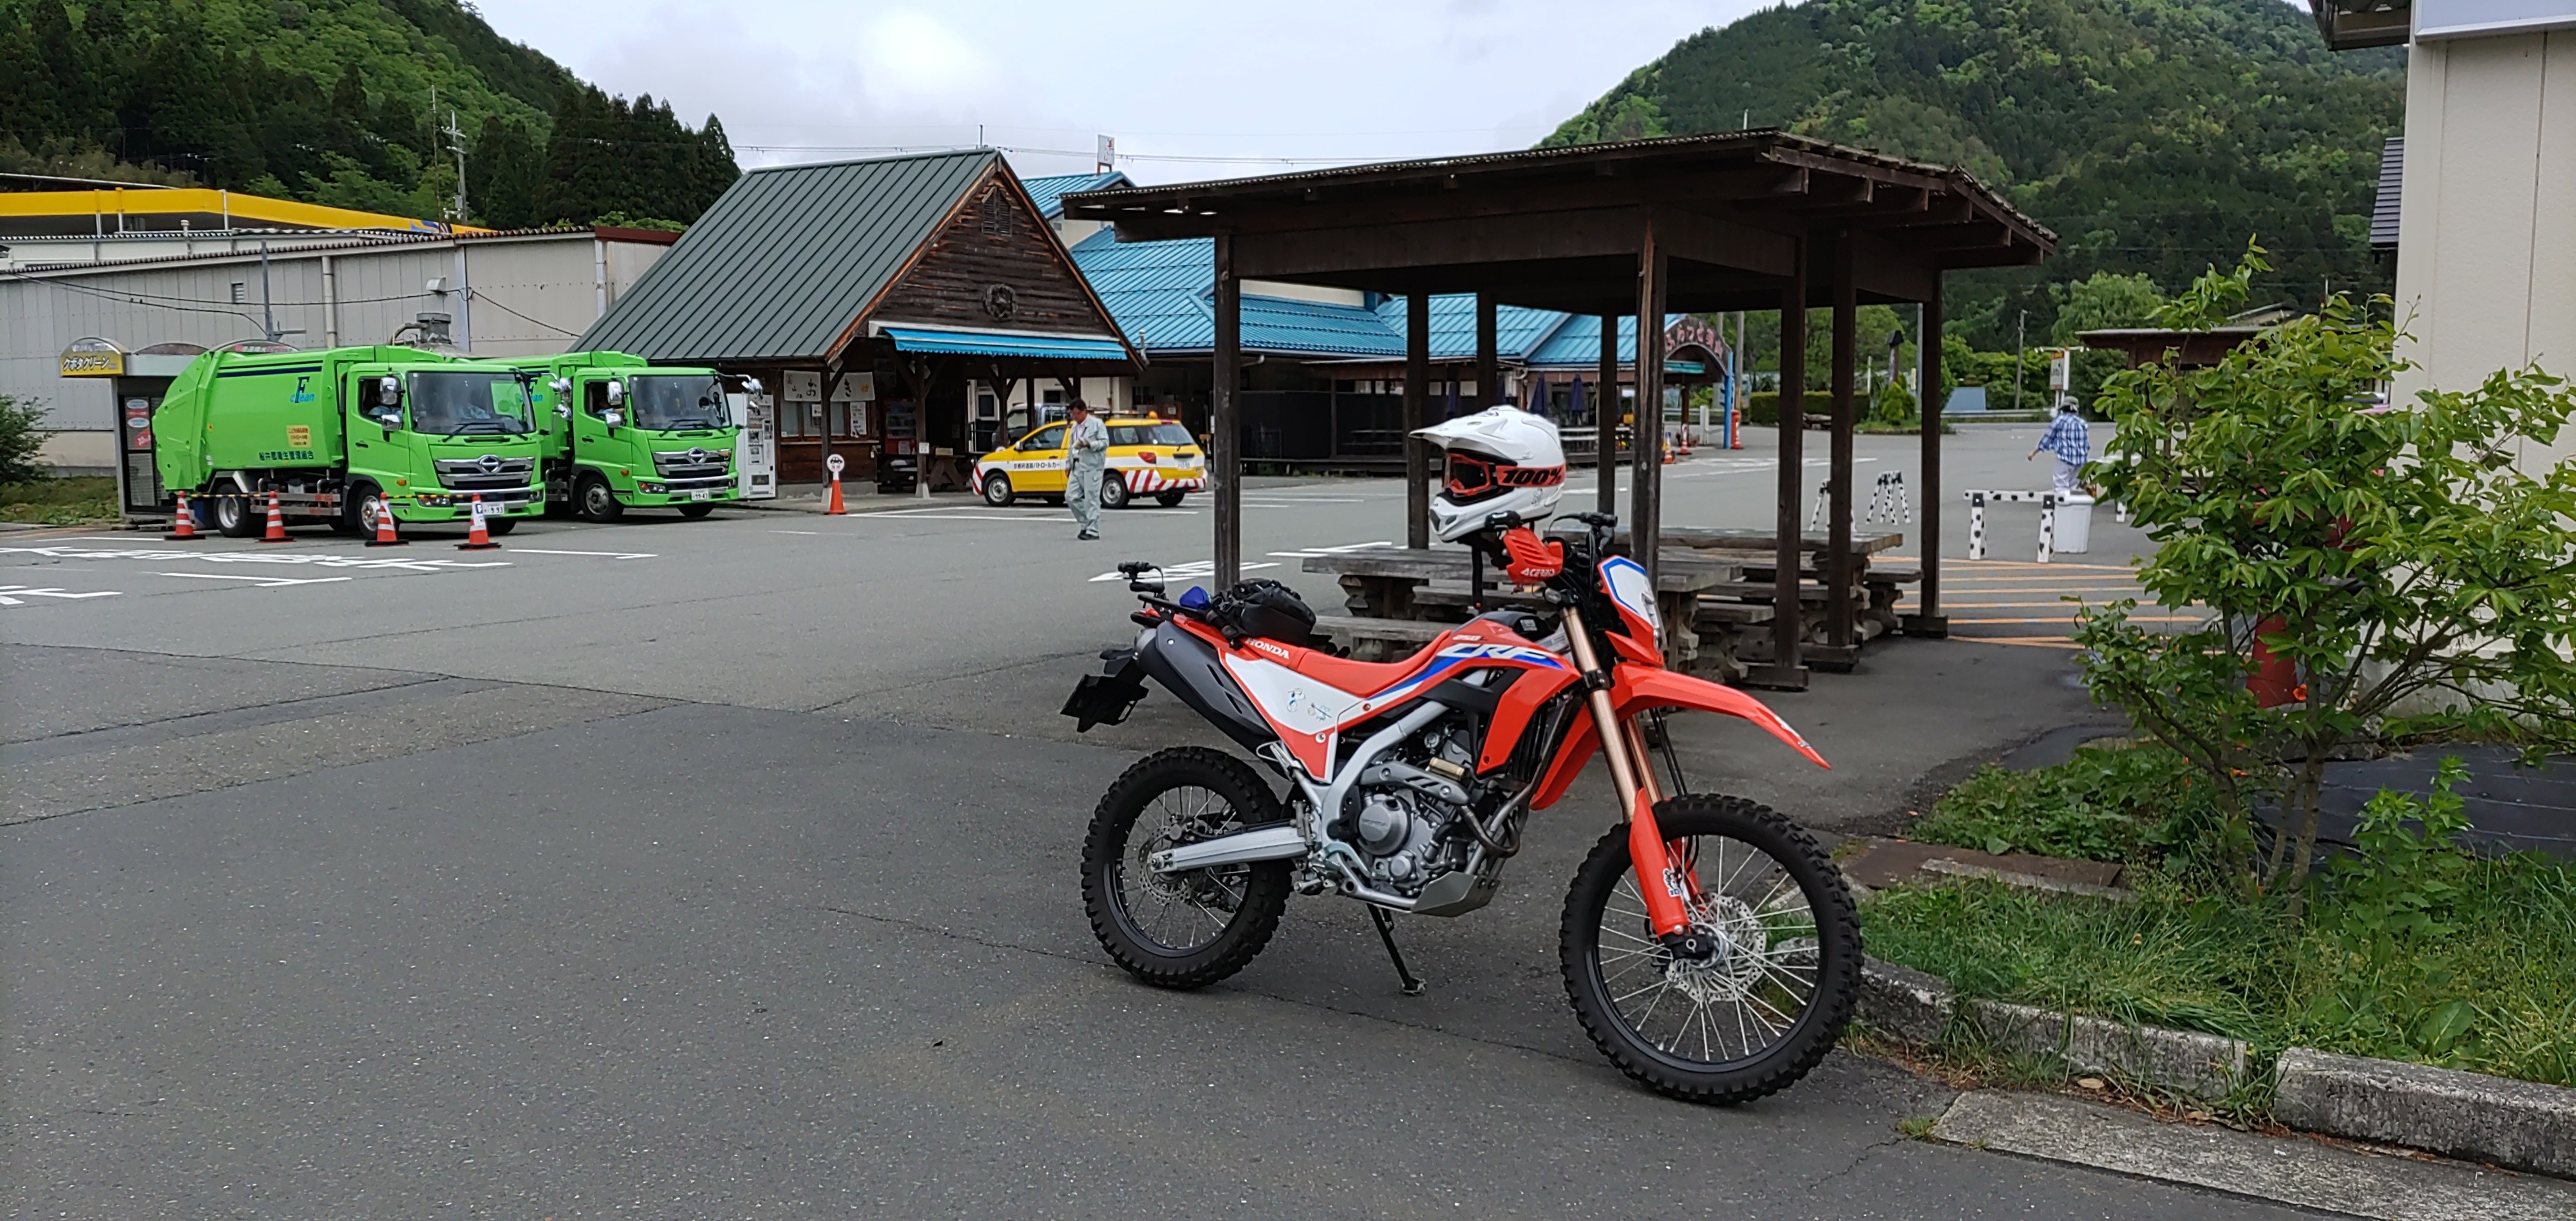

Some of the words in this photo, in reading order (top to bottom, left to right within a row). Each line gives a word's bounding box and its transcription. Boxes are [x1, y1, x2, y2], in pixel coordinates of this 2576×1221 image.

[63, 355, 109, 371] クボタクリーン
[1501, 467, 1562, 486] 100%
[1245, 637, 1290, 659] HONDA
[1437, 643, 1560, 660] CRF
